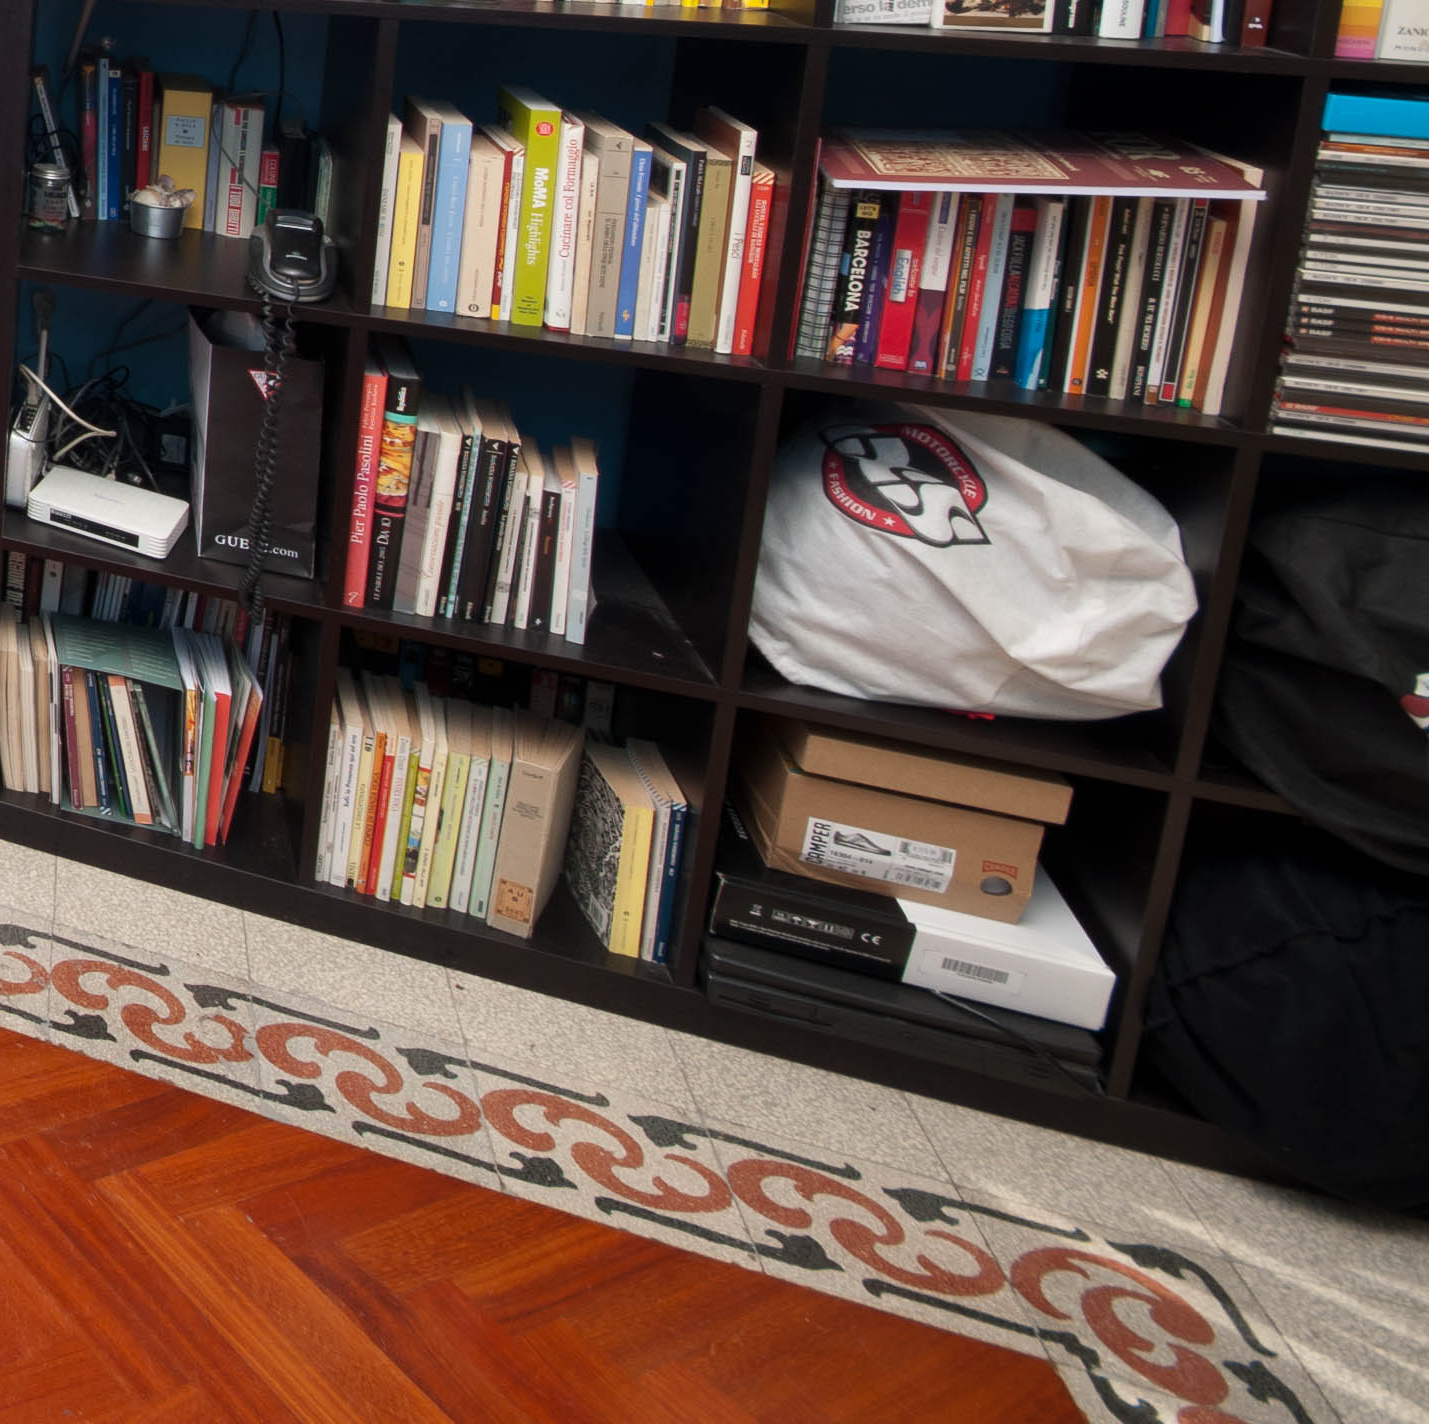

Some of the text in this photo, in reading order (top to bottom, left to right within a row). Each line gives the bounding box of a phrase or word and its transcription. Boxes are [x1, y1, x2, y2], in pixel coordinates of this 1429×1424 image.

[525, 167, 550, 265] MoMA Highlights
[559, 139, 580, 258] Cucinare col Formaggio
[844, 230, 872, 312] BARCELONA
[892, 256, 909, 295] English
[908, 258, 919, 288] welcome
[350, 434, 374, 544] Pier Paolo Pasolini
[828, 473, 877, 521] FASHION
[805, 822, 831, 864] CAMPER
